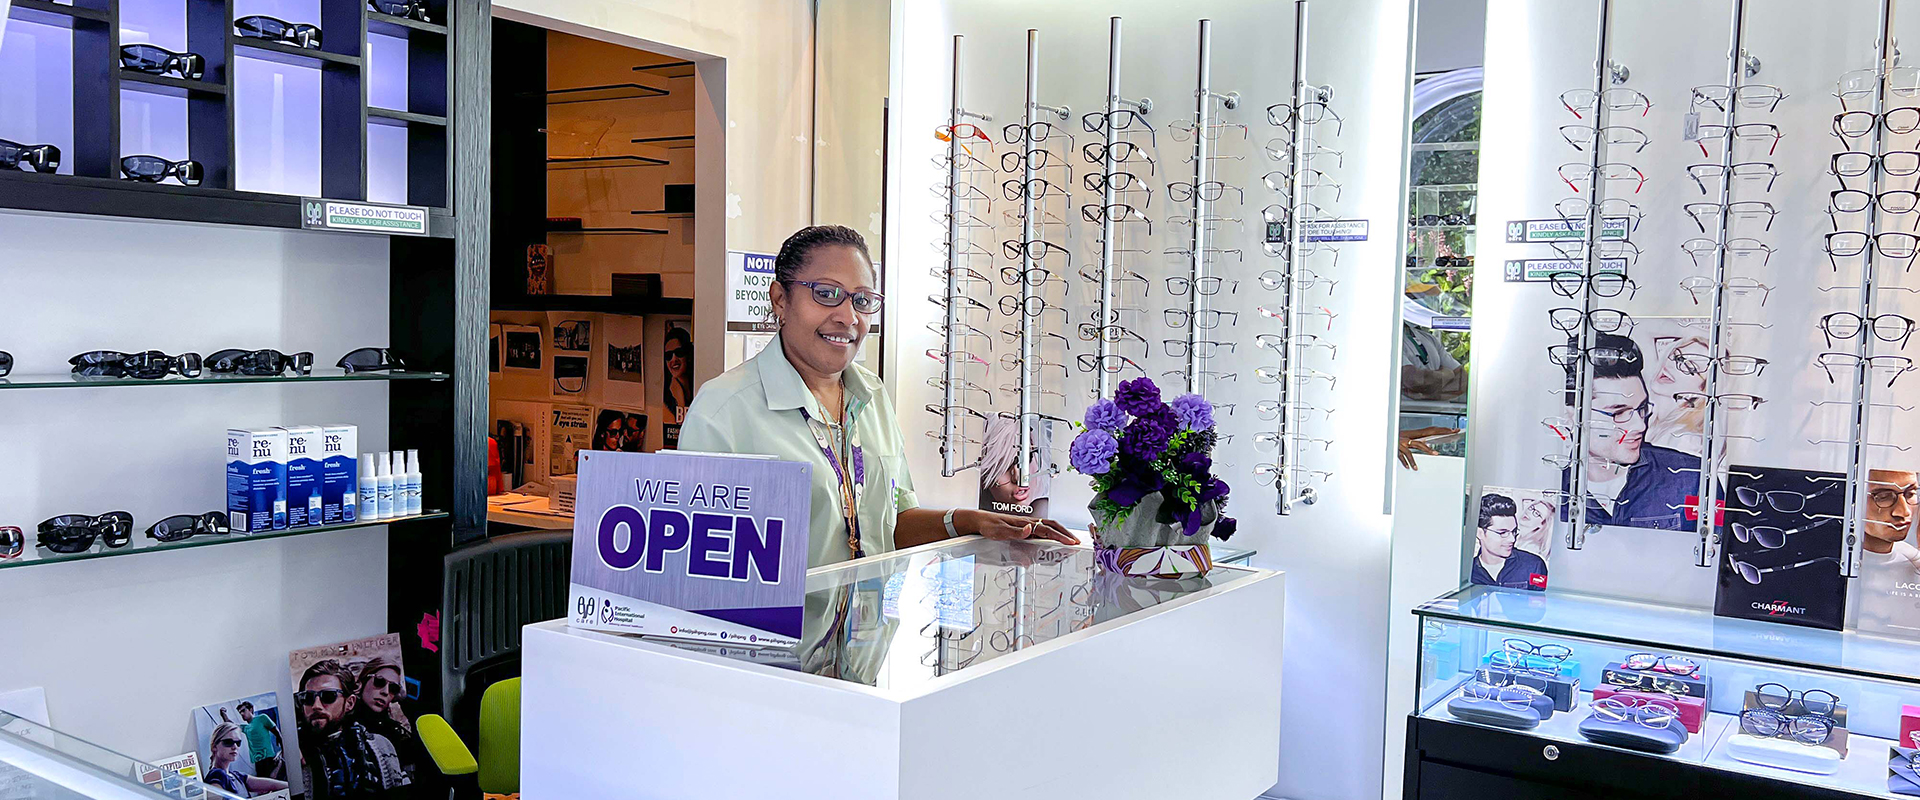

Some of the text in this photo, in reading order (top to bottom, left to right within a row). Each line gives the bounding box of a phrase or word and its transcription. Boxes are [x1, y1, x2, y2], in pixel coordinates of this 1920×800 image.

[329, 206, 422, 221] PLEASE DO NOT TOUCH
[332, 216, 354, 224] KINDLY
[356, 217, 368, 225] ASK
[383, 219, 419, 229] ASSISTANCE
[1560, 222, 1572, 230] DO
[746, 257, 775, 270] NOTI
[1600, 261, 1623, 269] OUCH
[743, 275, 759, 285] NO
[748, 305, 770, 316] POIN
[552, 410, 561, 426] 7
[558, 420, 588, 428] eye strain
[228, 447, 239, 456] nu
[289, 445, 306, 454] nu
[325, 443, 341, 451] nu
[252, 449, 271, 457] nu
[635, 478, 751, 510] WE ARE
[991, 501, 1033, 514] TOM FORD
[596, 503, 785, 585] OPEN
[1751, 601, 1806, 615] CHARMANT
[614, 611, 645, 619] International
[294, 646, 336, 660] TOMMY
